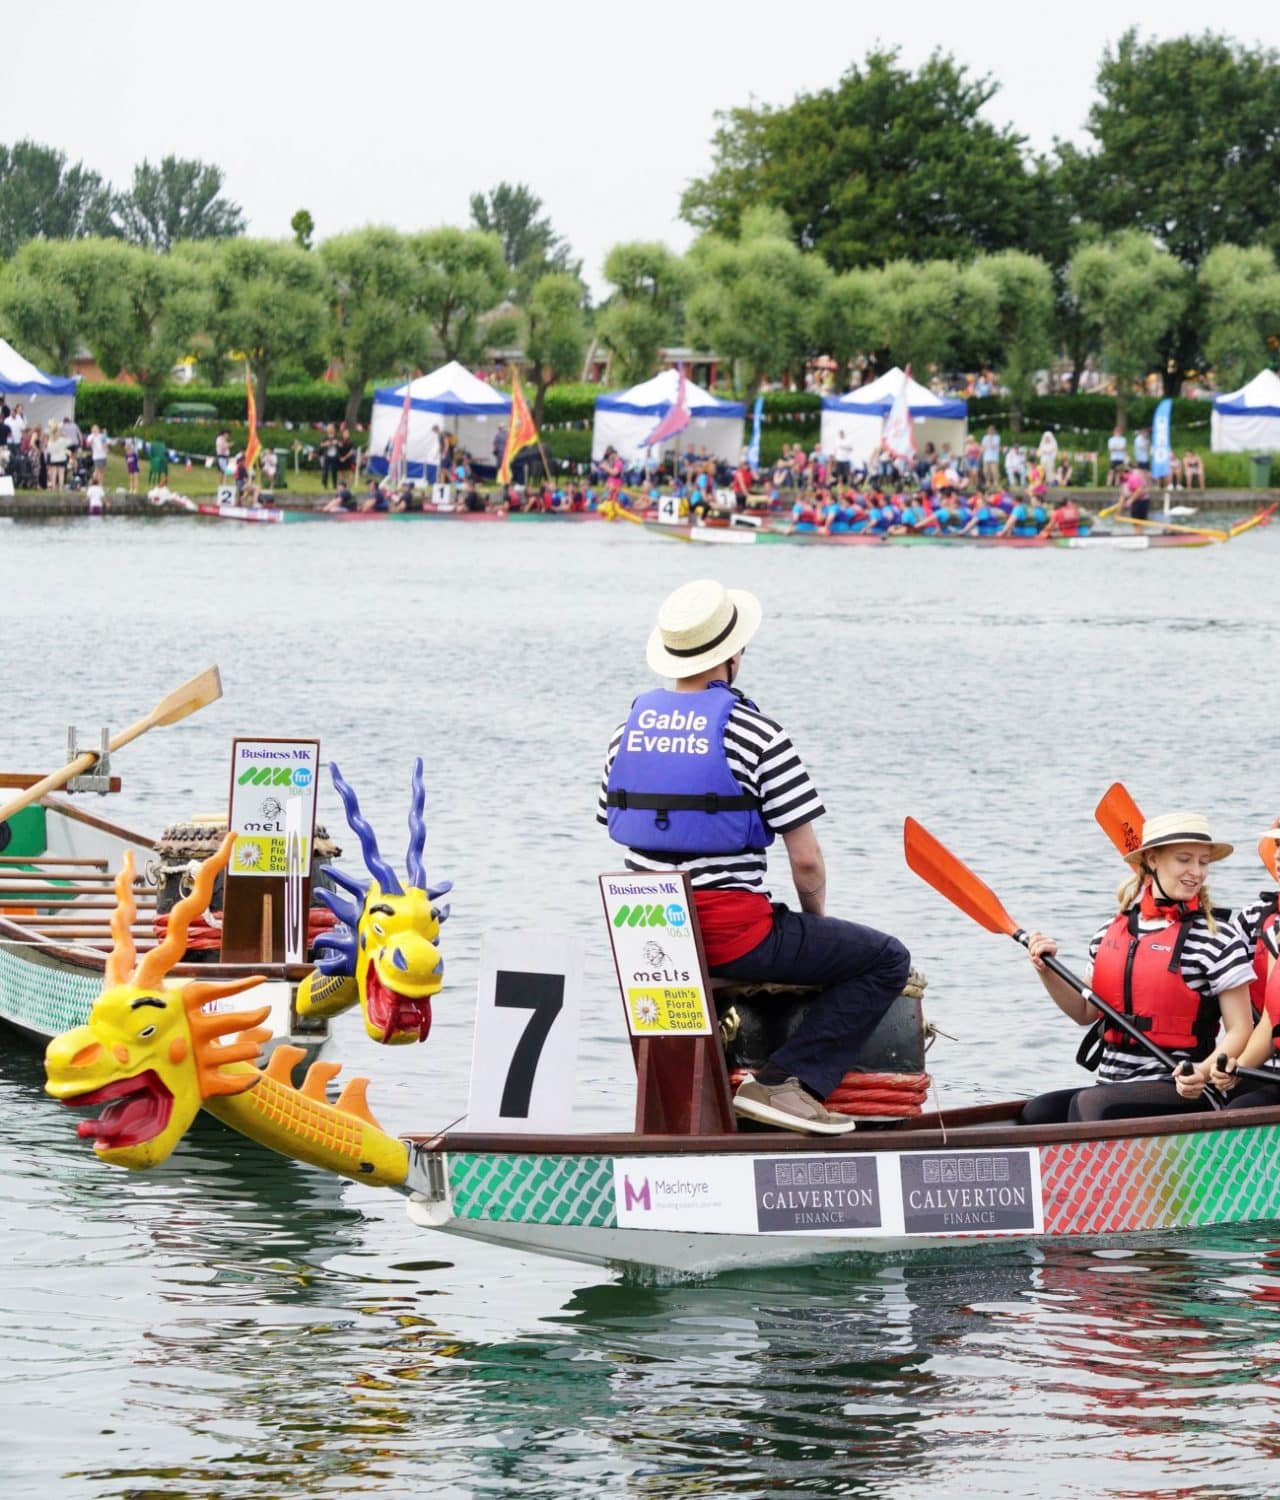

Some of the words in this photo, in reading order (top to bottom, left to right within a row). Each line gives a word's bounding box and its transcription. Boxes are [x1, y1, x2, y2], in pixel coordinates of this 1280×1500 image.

[221, 490, 232, 504] 2
[663, 501, 674, 516] 4
[637, 709, 708, 731] Gable
[626, 730, 710, 754] Events
[241, 749, 290, 760] Business
[291, 750, 311, 760] MK
[608, 883, 658, 896] Business
[659, 882, 679, 894] MK
[664, 990, 697, 999] Ruth's
[666, 1000, 695, 1009] Floral
[668, 1010, 704, 1021] Design
[670, 1021, 702, 1030] Studio
[494, 970, 566, 1119] 7
[655, 1180, 710, 1198] MacIntyre
[762, 1189, 874, 1210] CALVERTON
[909, 1187, 1027, 1209] CALVERTON
[794, 1211, 846, 1225] FINANCE
[943, 1211, 997, 1226] FINANCE
